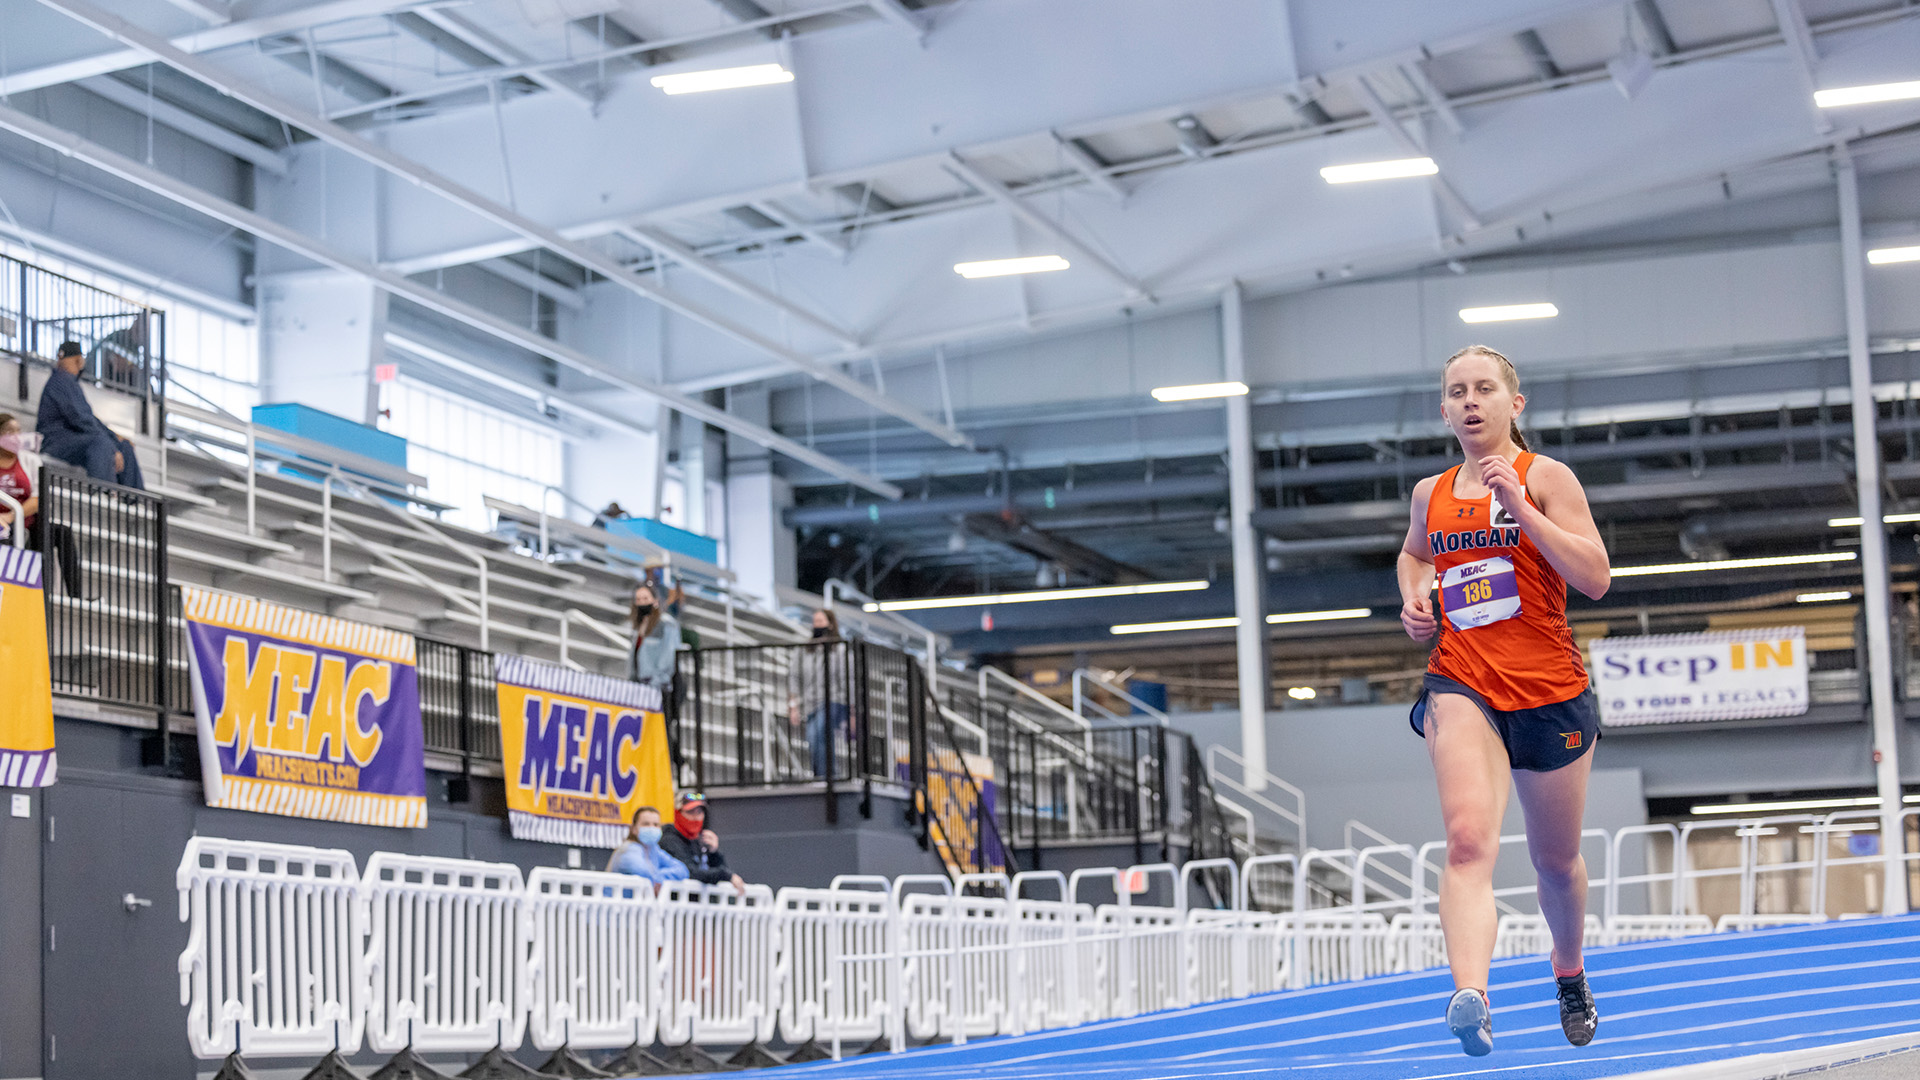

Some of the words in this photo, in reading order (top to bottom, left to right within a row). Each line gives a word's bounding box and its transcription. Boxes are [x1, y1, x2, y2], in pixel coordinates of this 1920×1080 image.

[1428, 528, 1521, 557] MORGAN
[1460, 563, 1488, 578] MEAC
[1462, 578, 1493, 604] 136
[1603, 653, 1717, 683] Step
[1730, 639, 1794, 670] IN
[214, 635, 392, 771] MEAC
[518, 693, 647, 808] MEAC
